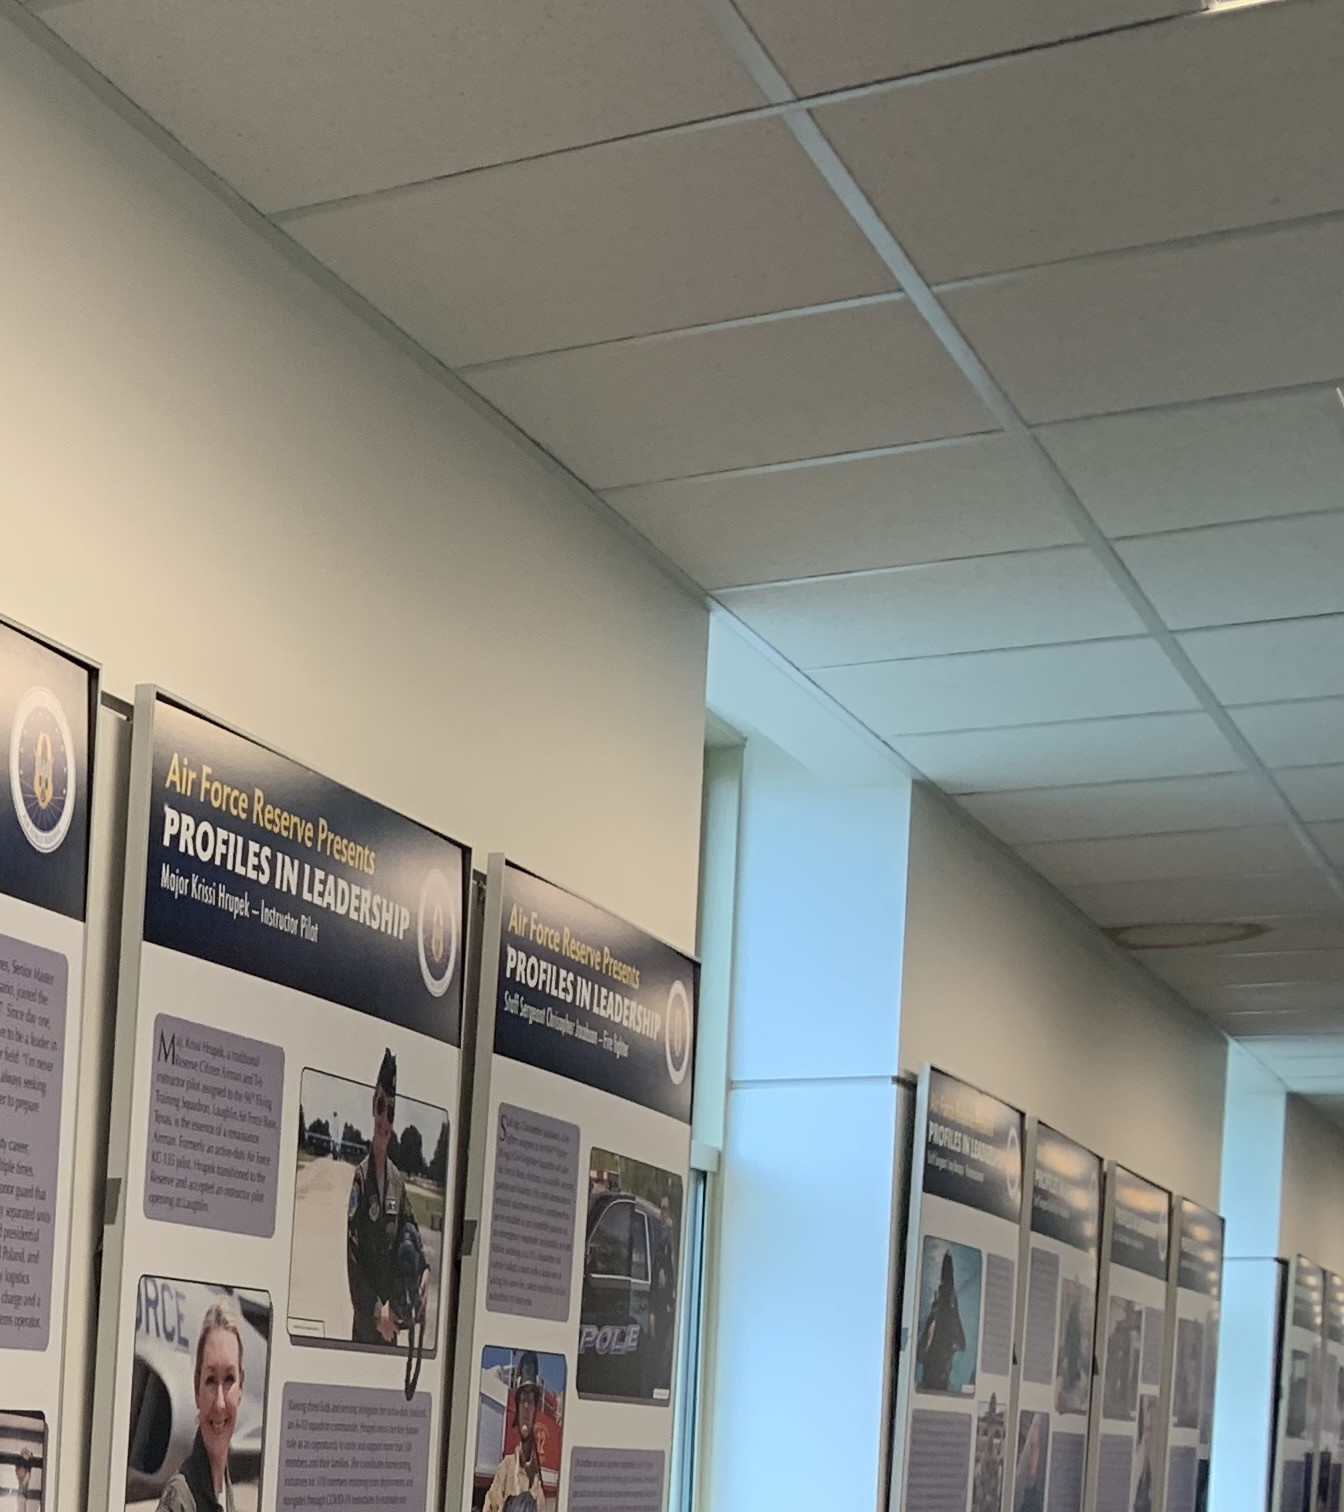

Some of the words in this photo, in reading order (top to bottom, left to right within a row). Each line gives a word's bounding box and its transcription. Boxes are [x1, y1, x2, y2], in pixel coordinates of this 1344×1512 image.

[163, 806, 271, 884] PROFILES
[274, 852, 299, 896] IN
[302, 864, 409, 939] LEADERSHIP
[165, 753, 196, 795] Air
[200, 765, 248, 819] Force
[253, 789, 314, 847] Reserve
[317, 818, 375, 875] Presents
[506, 945, 574, 1003] PROFILES
[575, 976, 592, 1010] IN
[592, 985, 661, 1039] LEADERSHIP
